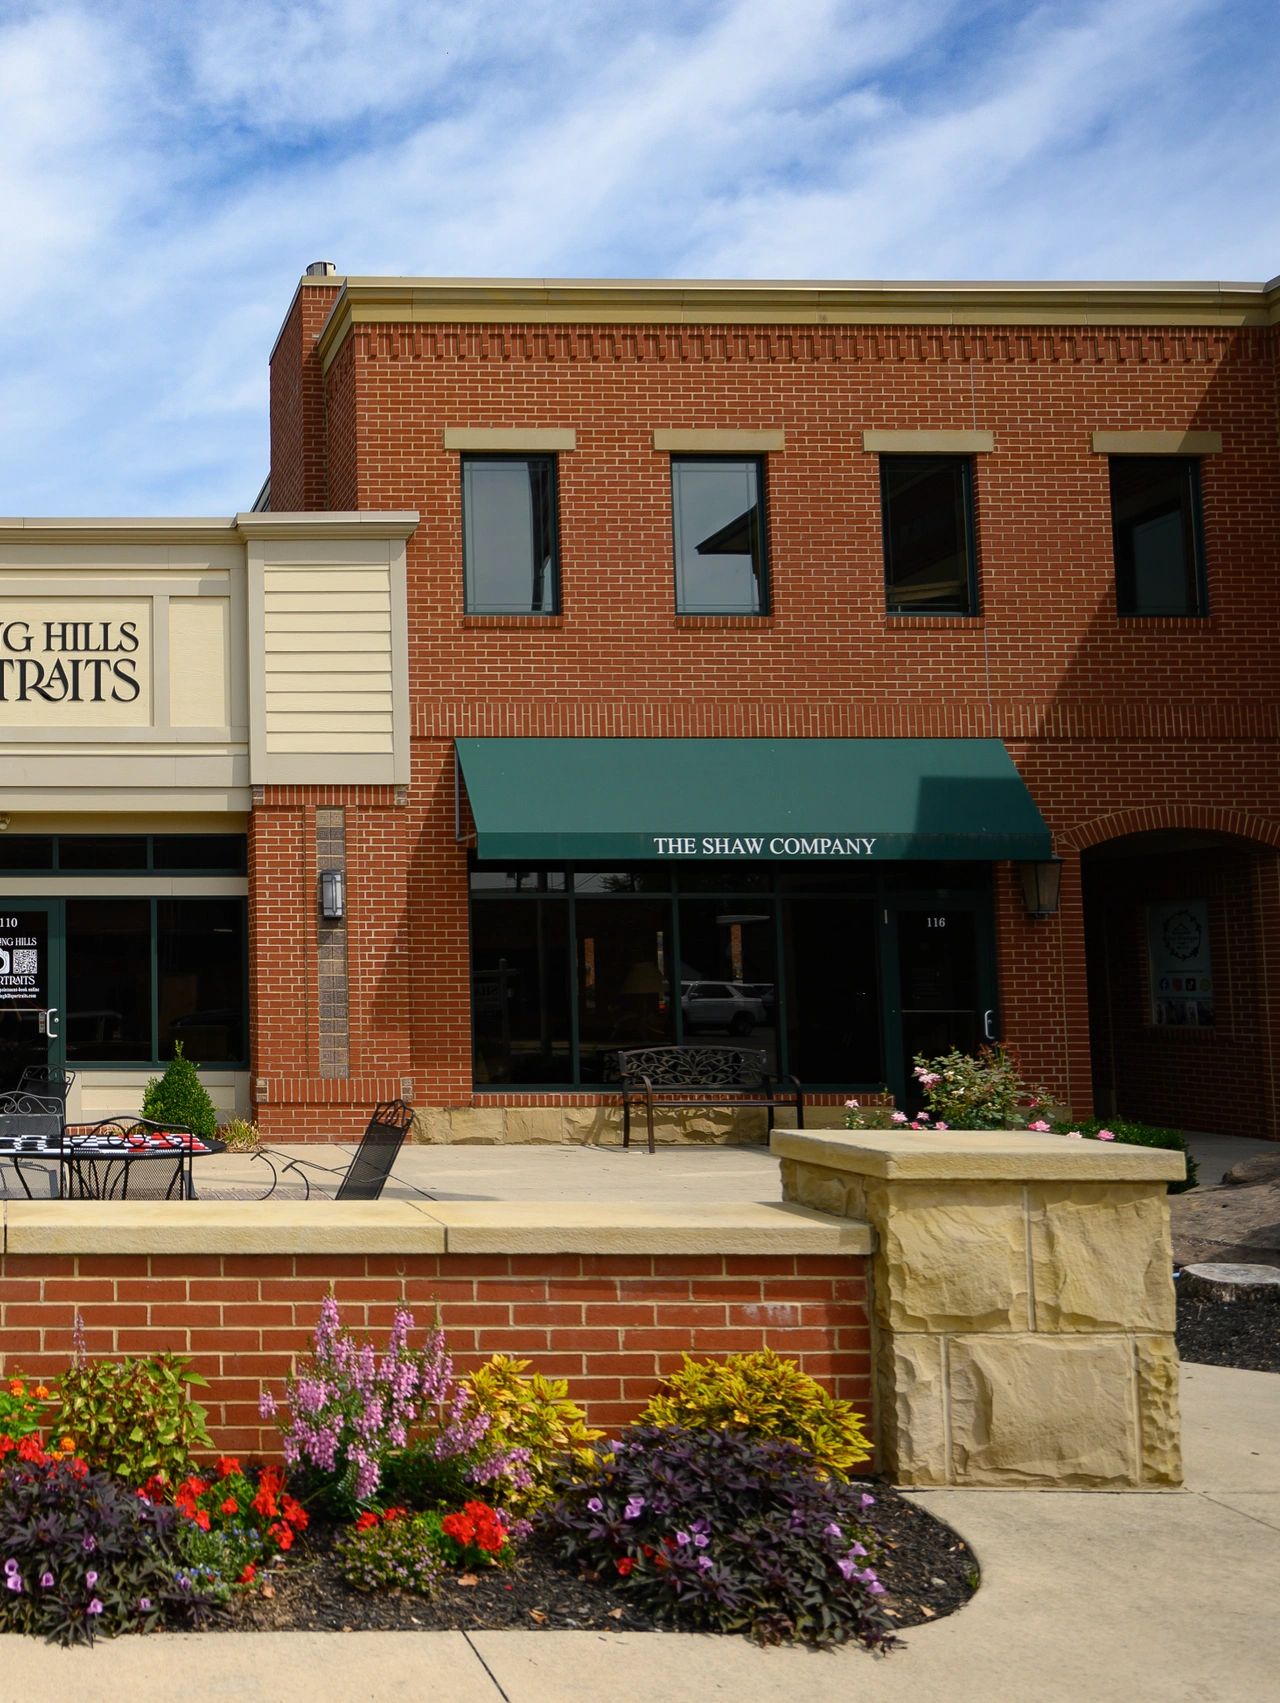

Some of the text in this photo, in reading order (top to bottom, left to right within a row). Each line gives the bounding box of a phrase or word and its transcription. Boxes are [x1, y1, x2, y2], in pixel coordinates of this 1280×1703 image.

[42, 622, 140, 652] HILLS
[653, 838, 878, 855] THE SHAW COMPANY
[0, 917, 18, 928] 110
[927, 917, 946, 927] 116
[15, 937, 37, 946] HILLS
